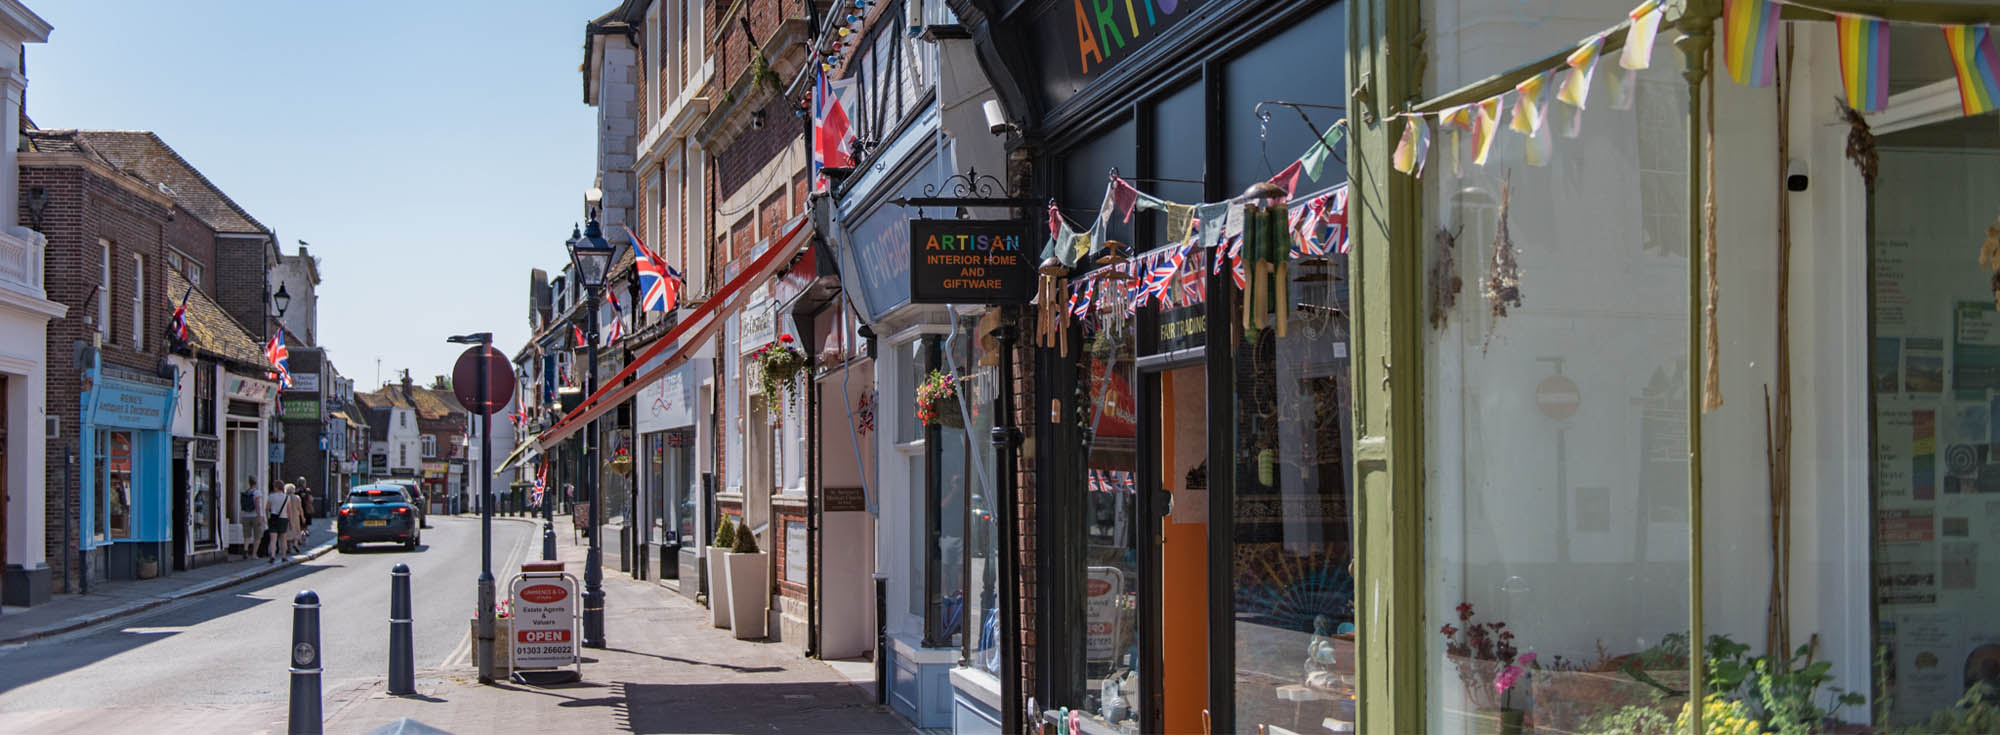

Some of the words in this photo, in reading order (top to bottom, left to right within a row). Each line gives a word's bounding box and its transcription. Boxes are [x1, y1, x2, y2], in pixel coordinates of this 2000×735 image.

[925, 234, 1019, 251] ARTISAN
[927, 255, 981, 265] INTERIOR
[984, 255, 1017, 265] HOME
[960, 267, 985, 277] AND
[943, 279, 1002, 289] GIFTWARE
[1160, 322, 1176, 341] FAIR
[1176, 315, 1206, 337] TRADING
[526, 631, 562, 641] OPEN
[517, 647, 541, 655] 01303
[543, 646, 571, 654] 266022
